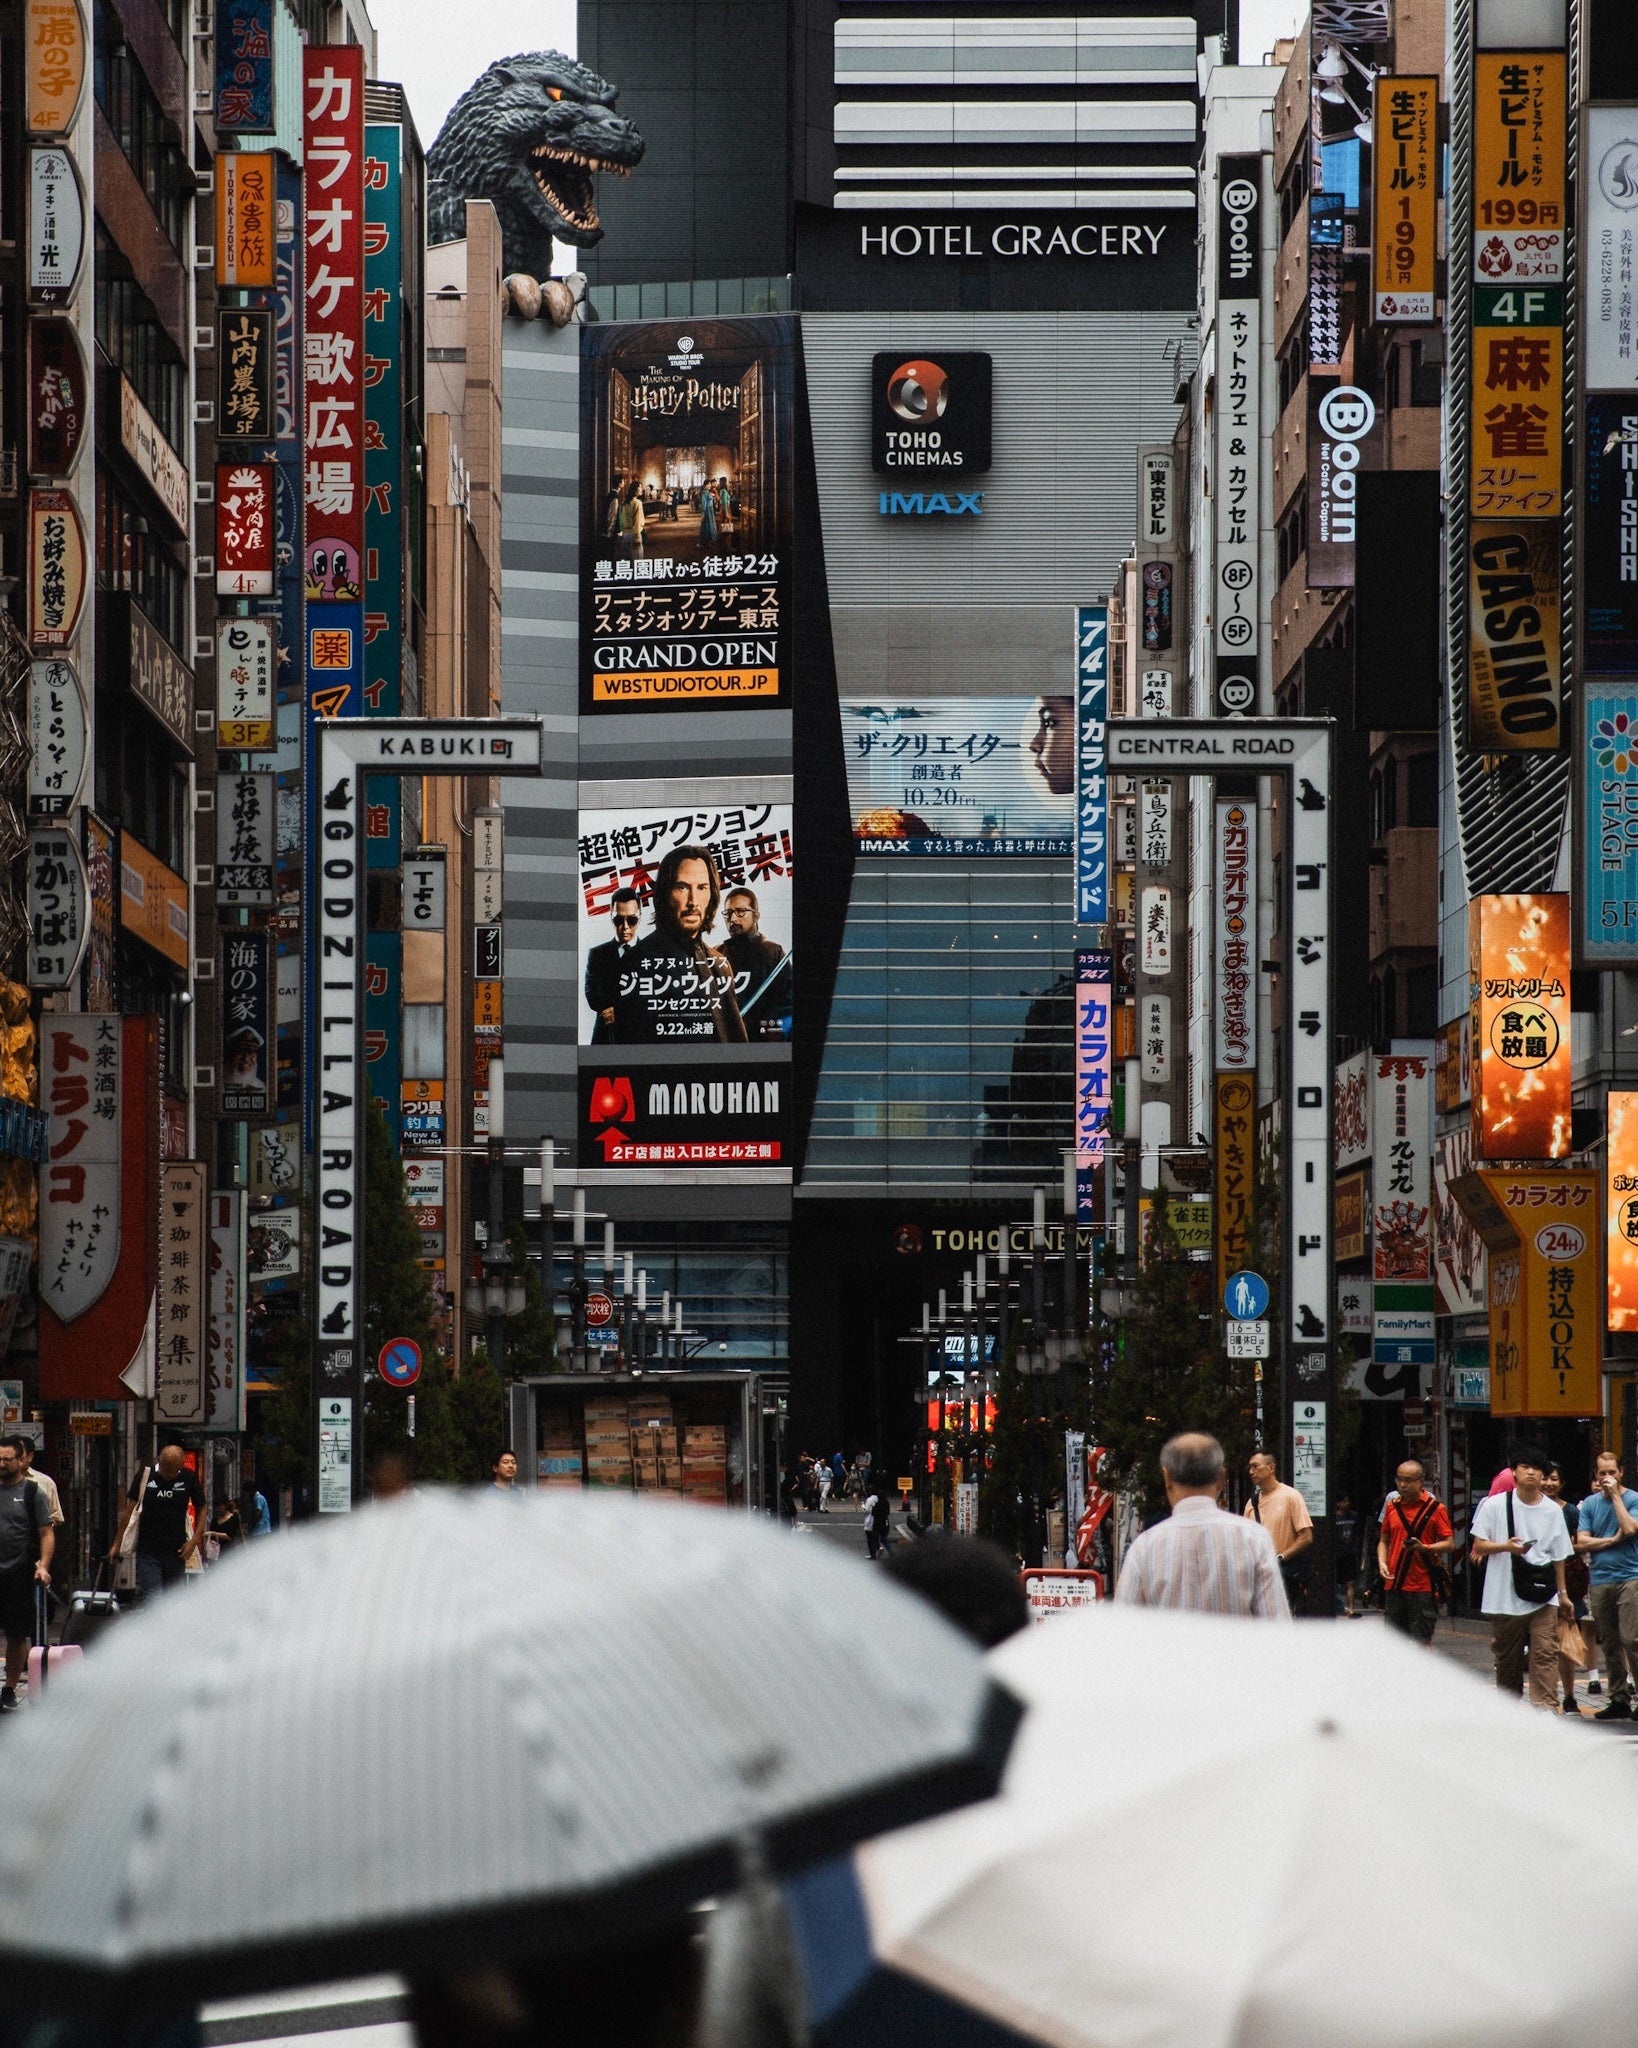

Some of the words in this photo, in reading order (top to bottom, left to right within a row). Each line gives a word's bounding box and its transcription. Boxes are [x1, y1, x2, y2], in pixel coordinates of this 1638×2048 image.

[34, 17, 75, 97] 虎の子
[218, 18, 269, 125] 海の家
[33, 111, 60, 125] 4F
[1498, 65, 1529, 188] 生ビール
[1532, 64, 1544, 187] ザ・プレミアム・モルツ
[1390, 91, 1416, 190] 生ビール
[1418, 91, 1428, 190] ザ・プレミアム・モルツ
[1480, 199, 1559, 225] 199円
[861, 225, 982, 255] HOTEL
[991, 224, 1167, 255] GRACERY
[1222, 179, 1258, 279] Booth
[1395, 196, 1415, 284] 199円
[40, 244, 60, 267] 光
[1515, 262, 1558, 276] 鳥メロ
[307, 66, 355, 515] カラオケ歌広場
[1601, 229, 1612, 322] 03-6228-0830
[41, 288, 56, 301] 4F
[1491, 291, 1546, 323] 4F
[1618, 229, 1632, 359] 美容外科・美容皮膚科
[230, 316, 260, 421] 山内農場
[1229, 311, 1249, 427] ネットカフェ
[630, 384, 684, 421] Harry
[685, 378, 741, 416] Potter
[1484, 336, 1551, 459] 麻雀
[67, 413, 77, 447] 3F
[236, 421, 253, 434] 5F
[886, 432, 941, 448] TOHO
[886, 452, 963, 466] CINEMAS
[1229, 438, 1246, 456] &
[1321, 443, 1329, 460] Net
[1320, 463, 1329, 488] Cafe
[1477, 467, 1537, 487] スリー
[879, 492, 985, 515] IMAX
[1150, 470, 1166, 535] 東京ビル
[1227, 465, 1248, 545] カプセル
[1476, 490, 1556, 511] ファイブ
[220, 495, 244, 565] さかい
[245, 489, 265, 549] 焼肉屋
[1319, 500, 1329, 542] Capsule
[42, 515, 66, 629] お好み焼き
[593, 553, 778, 581] 豊島園駅から徒歩2分
[1228, 568, 1247, 584] 8F
[232, 573, 257, 594] 4F
[594, 592, 672, 613] ワーナー
[679, 586, 779, 609] ブラザース
[593, 606, 779, 634] スタジオツアー東京
[1228, 624, 1247, 639] 5F
[1473, 533, 1558, 736] CASINO
[33, 631, 64, 643] 2階
[315, 633, 348, 665] 薬
[593, 643, 697, 669] GRAND
[701, 640, 777, 667] OPEN
[1081, 620, 1106, 706] 747
[604, 675, 768, 695] WBSTUDIOTOUR.JP
[46, 690, 68, 790] とらそば
[232, 723, 261, 744] 3F
[380, 738, 513, 759] KABUKI町
[853, 733, 1022, 764] ザ・クリエイター
[1118, 739, 1225, 754] CENTRAL
[1232, 739, 1294, 754] ROAD
[910, 763, 963, 781] 創造者
[38, 798, 63, 812] 1F
[230, 776, 262, 863] お好み焼
[1080, 718, 1106, 913] カラオケランド
[579, 804, 772, 867] 超絶アクション
[1602, 781, 1622, 870] STAGE
[860, 840, 910, 851] IMAX
[1224, 826, 1250, 916] カラオケ
[34, 858, 69, 946] かっぱ
[485, 929, 500, 967] ダーツ
[641, 957, 729, 970] キアヌ・リーブス
[37, 957, 65, 974] B1
[230, 941, 258, 1021] 海の家
[323, 820, 353, 1114] GODZILLA
[1079, 968, 1109, 979] 747
[619, 971, 751, 997] ジョン・ウィック
[1485, 979, 1564, 998] ソフトクリーム
[647, 998, 722, 1011] コンセクエンス
[1222, 938, 1251, 1067] まねきねこ
[1502, 1011, 1547, 1034] 食べ
[1295, 863, 1327, 1256] ゴジラロード
[1501, 1036, 1548, 1058] 放題
[94, 1020, 118, 1121] 大衆酒場
[1079, 1000, 1109, 1132] カラオケ
[403, 1100, 442, 1114] つり具
[649, 1081, 780, 1115] MARUHAN
[48, 1031, 90, 1204] トラノコ
[407, 1116, 440, 1129] 釣具
[612, 1145, 772, 1160] 2F店舗出入口はビル左側
[1388, 1140, 1415, 1194] 九十九
[1506, 1185, 1593, 1207] カラオケ
[322, 1148, 353, 1288] ROAD
[932, 1229, 999, 1250] TOHO
[1545, 1231, 1580, 1252] 24H
[1377, 1319, 1432, 1331] FamilyMart
[1547, 1266, 1575, 1396] 持込OK!
[157, 1490, 173, 1498] AIG
